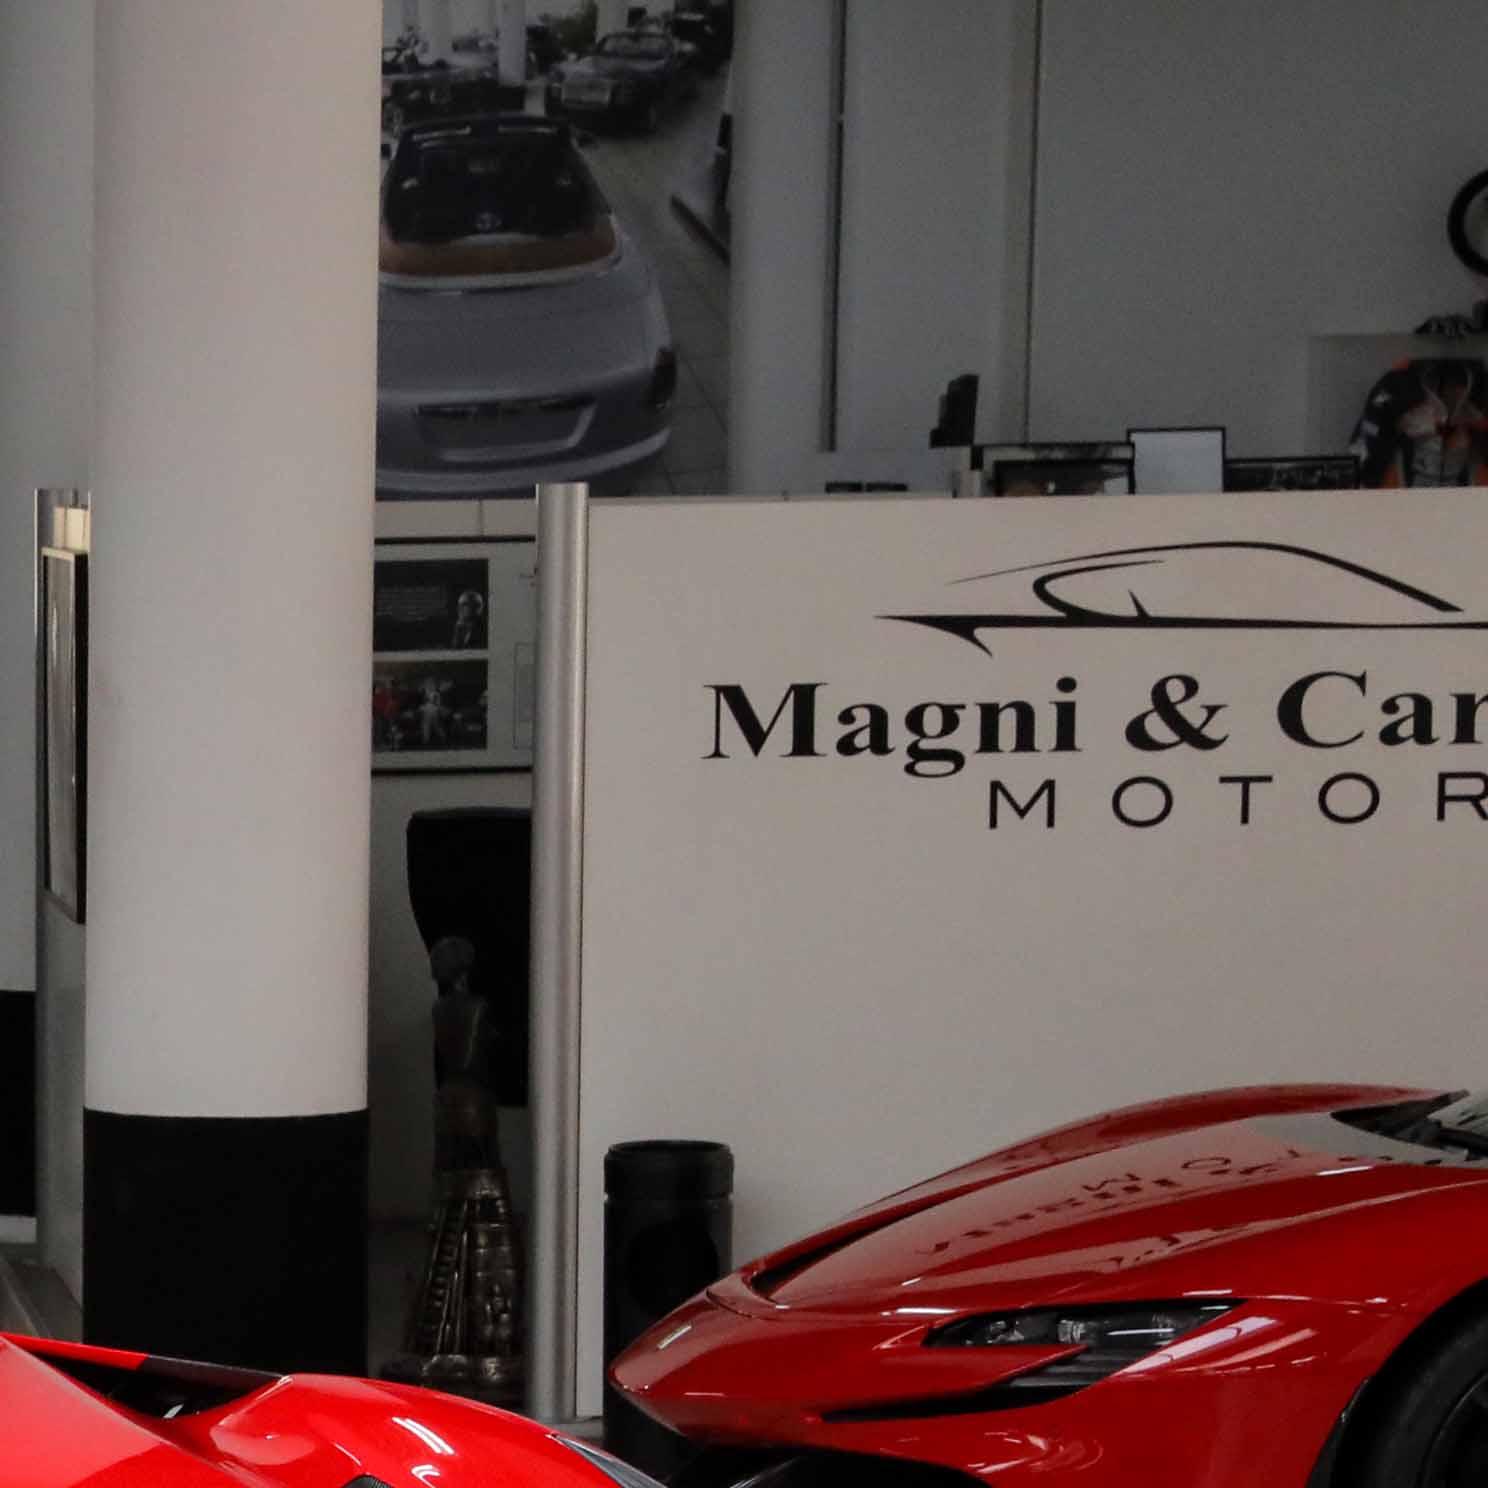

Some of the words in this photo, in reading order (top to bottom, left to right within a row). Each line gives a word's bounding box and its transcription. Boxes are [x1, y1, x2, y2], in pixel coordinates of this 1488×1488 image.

[702, 676, 1081, 779] Magni
[1124, 674, 1228, 752] &
[989, 771, 1488, 830] MOTOR
